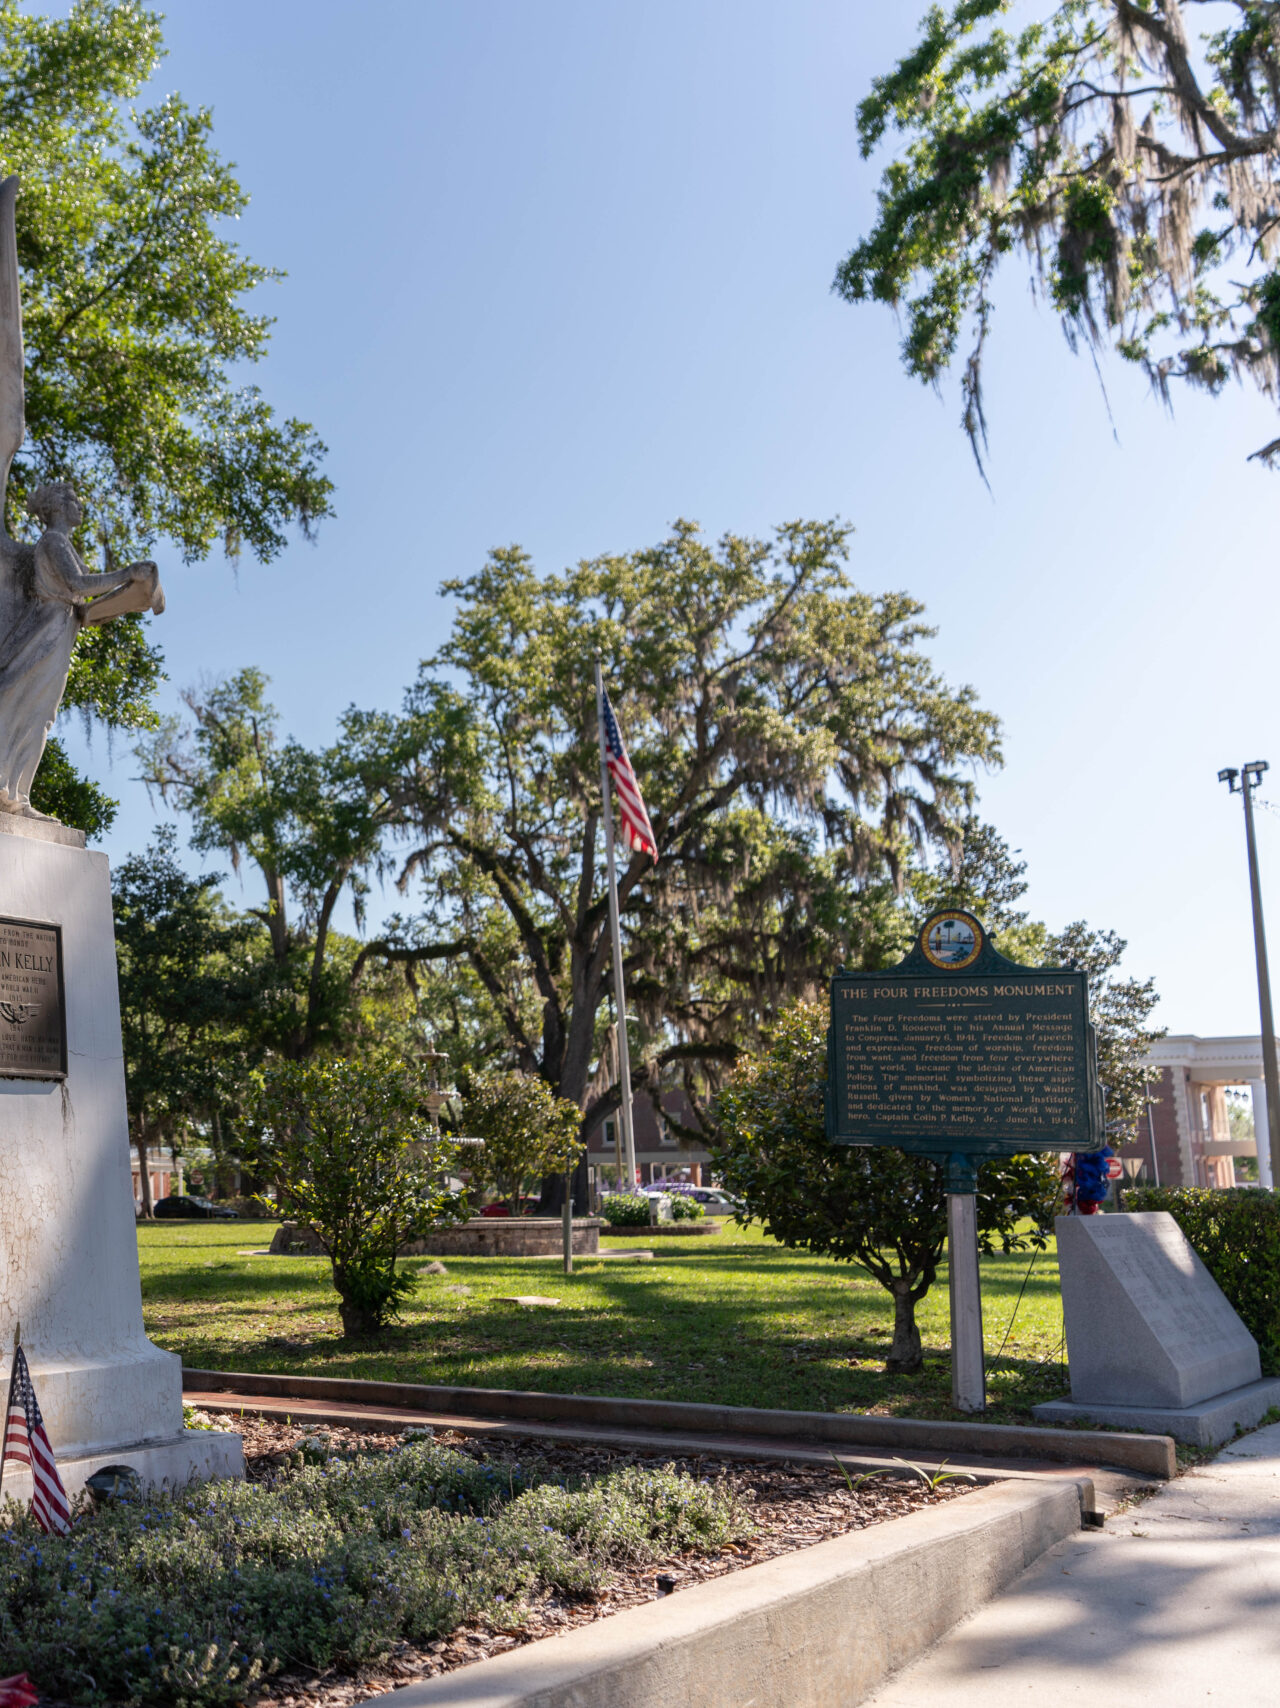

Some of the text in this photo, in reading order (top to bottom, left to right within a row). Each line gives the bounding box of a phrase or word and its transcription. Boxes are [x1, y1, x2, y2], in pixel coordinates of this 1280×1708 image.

[4, 929, 19, 937] FROM
[16, 953, 53, 972] KELLY
[2, 974, 29, 983] AMERICAN
[1, 984, 19, 992] WORLD
[841, 985, 1075, 999] THE FOUR FREEDOMS MONUMENT
[852, 1014, 869, 1022] The
[873, 1014, 894, 1022] Four
[898, 1014, 940, 1022] Freedoms
[1008, 1013, 1020, 1022] by
[1026, 1013, 1072, 1021] President
[845, 1024, 882, 1032] Franklin
[888, 1024, 896, 1032] D.
[902, 1024, 946, 1032] Roosevelt
[1032, 1024, 1072, 1032] Message
[904, 1034, 941, 1042] January
[1038, 1034, 1073, 1042] speech
[1014, 1054, 1074, 1062] everywhere
[977, 1064, 1005, 1072] ideals
[1028, 1064, 1074, 1072] American
[956, 1074, 1012, 1084] symbolizing
[974, 1085, 1016, 1093] designed
[1024, 1085, 1035, 1093] by
[1043, 1085, 1075, 1093] Walter
[888, 1093, 913, 1102] given
[920, 1094, 931, 1102] by
[984, 1095, 1023, 1103] National
[867, 1103, 911, 1111] dedicated
[1011, 1105, 1038, 1113] World
[1045, 1106, 1063, 1114] War
[876, 1113, 909, 1121] Captain
[913, 1113, 936, 1121] Colin
[1006, 1115, 1028, 1123] June
